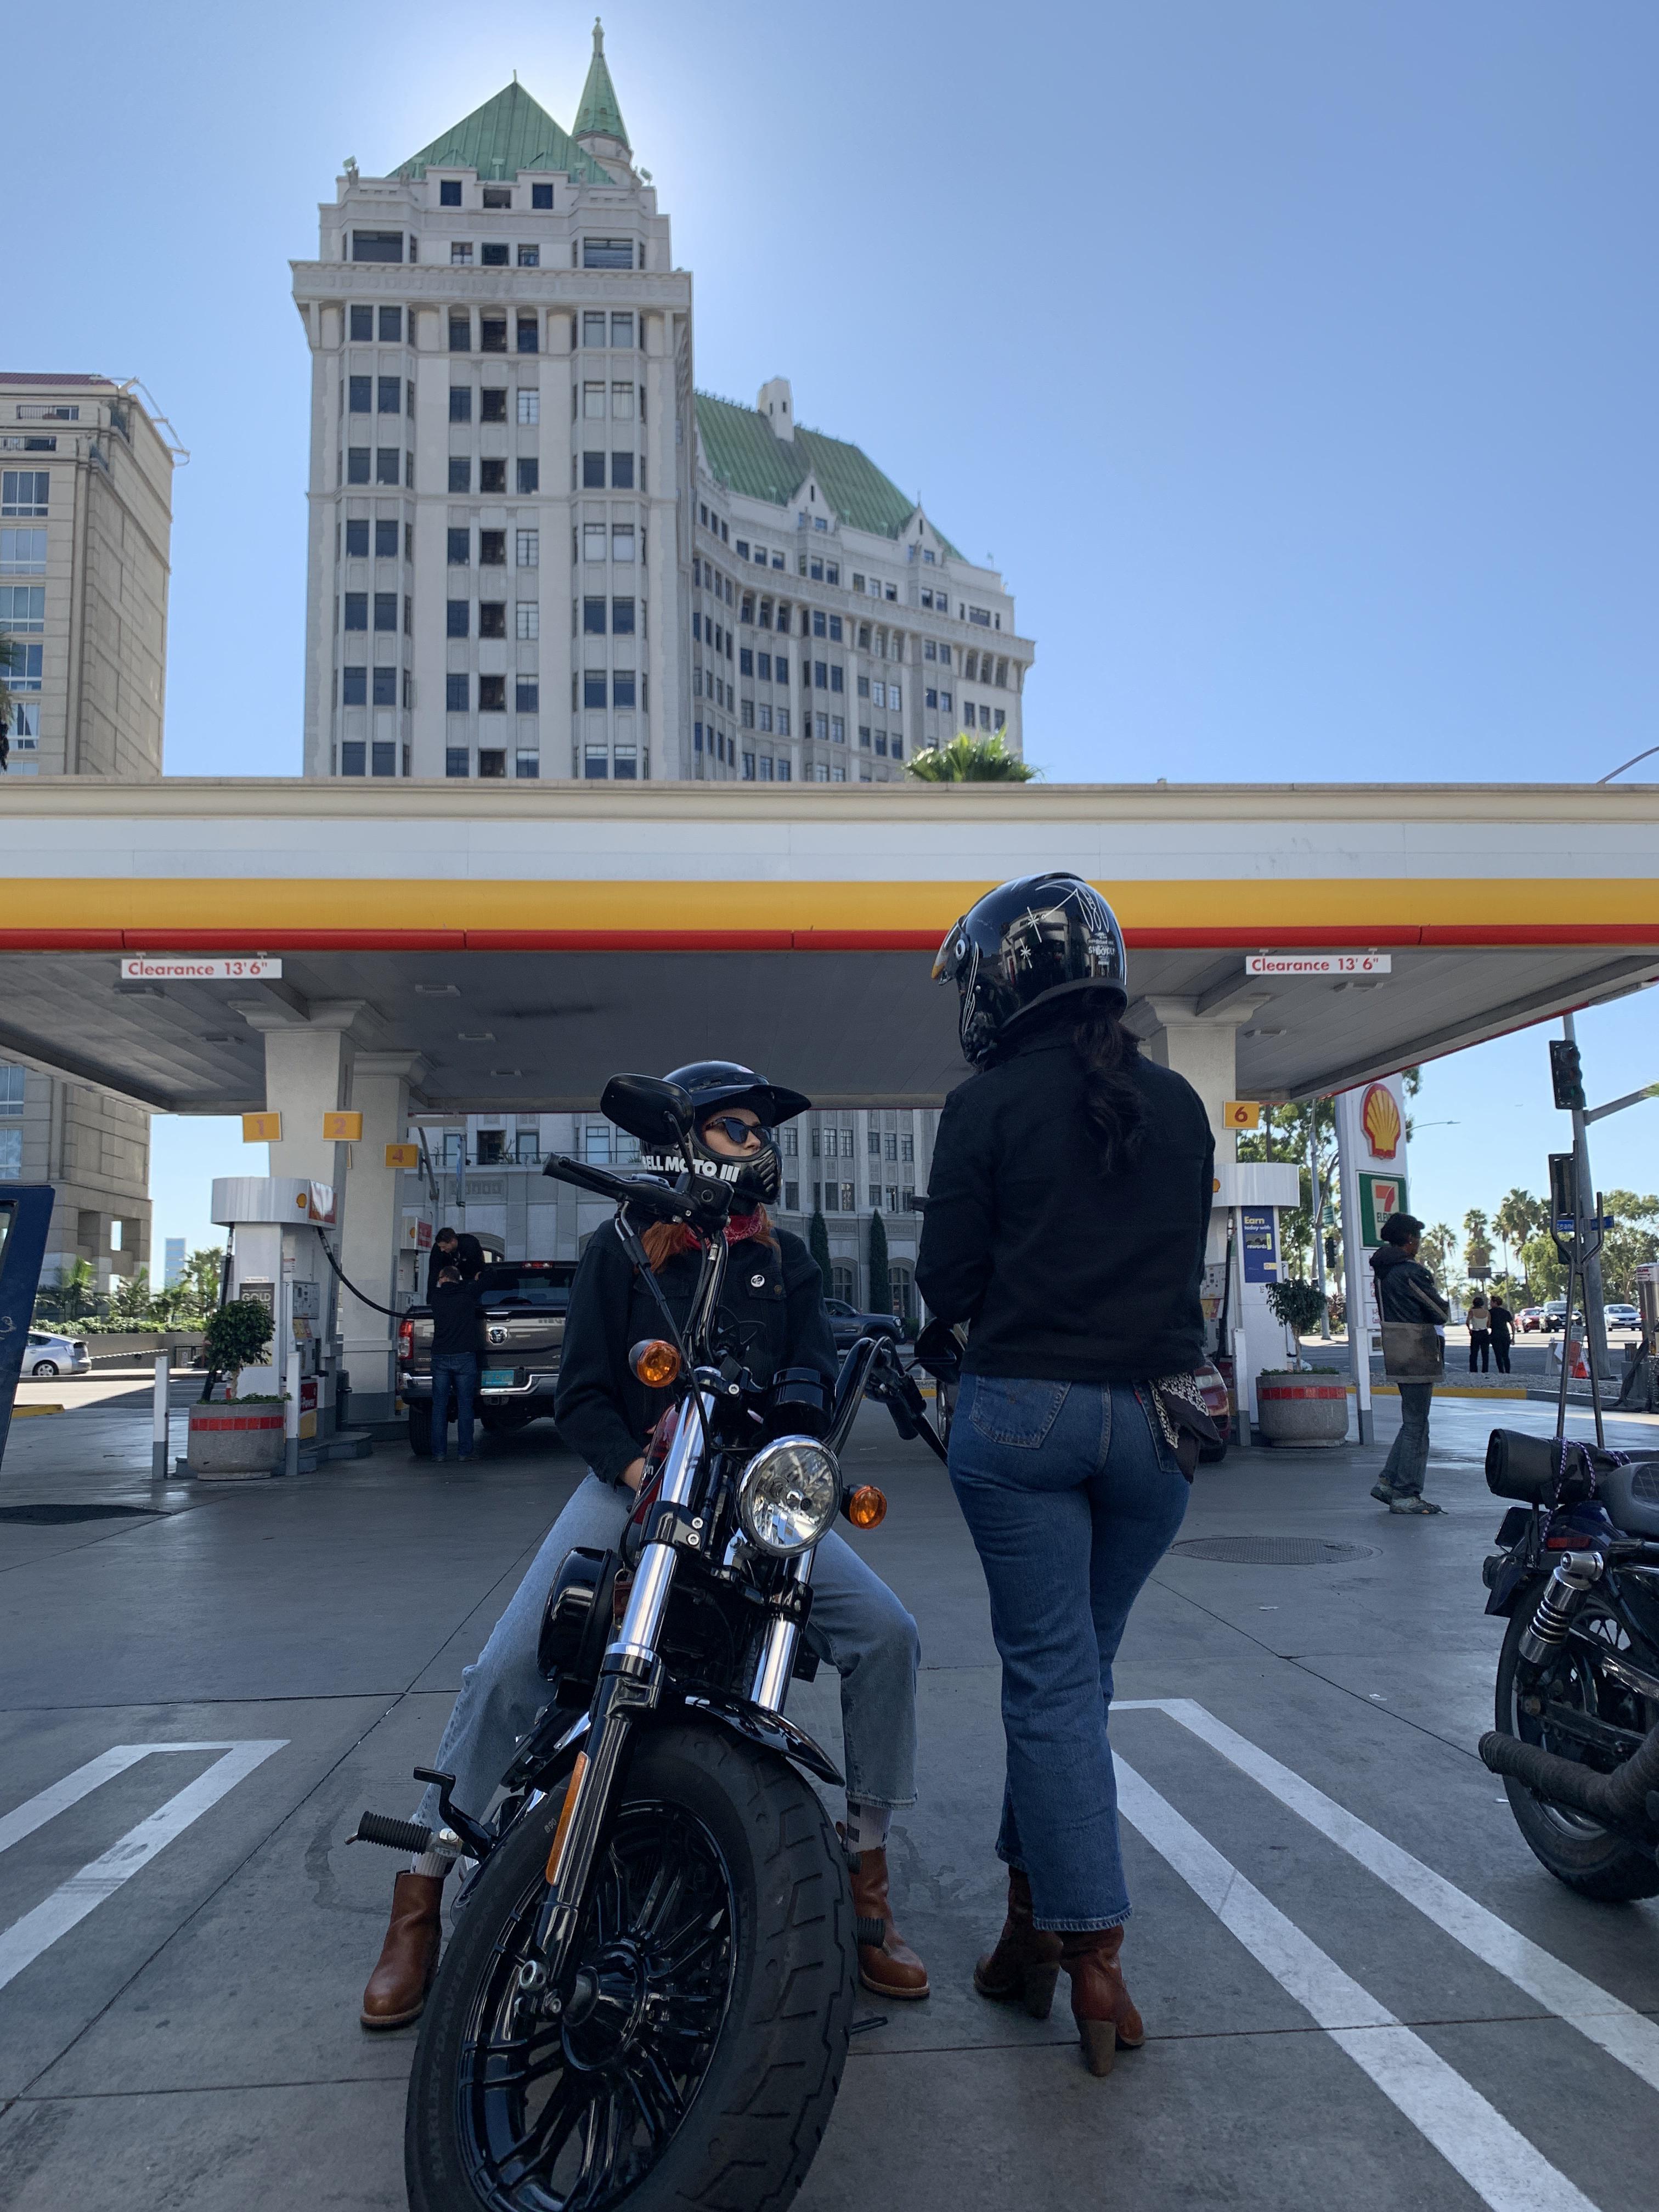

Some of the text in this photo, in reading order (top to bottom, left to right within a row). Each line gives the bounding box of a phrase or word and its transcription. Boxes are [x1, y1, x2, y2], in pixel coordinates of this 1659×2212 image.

[128, 961, 215, 975] Clearance
[1252, 957, 1330, 972] Clearance
[1234, 1106, 1248, 1122] 6
[256, 1118, 264, 1137] 1
[333, 1117, 346, 1135] 2
[392, 1148, 405, 1163] 4
[665, 1155, 718, 1177] MOTO
[719, 1164, 740, 1183] III
[1375, 1184, 1395, 1212] 7
[1244, 1216, 1265, 1224] Earn
[242, 1293, 272, 1302] GOLD
